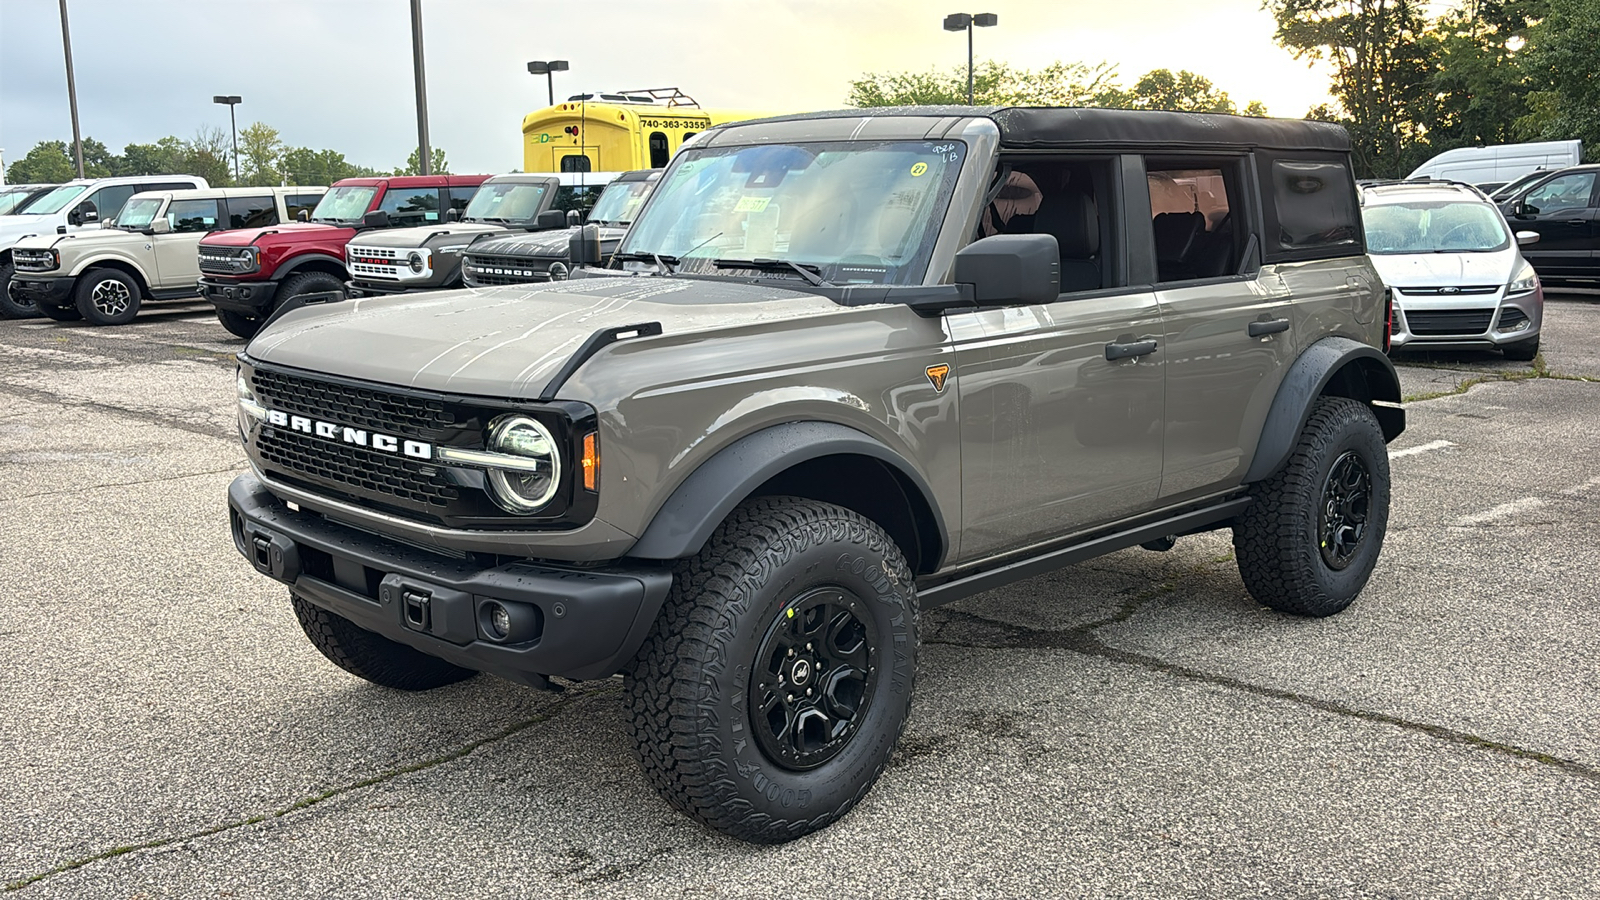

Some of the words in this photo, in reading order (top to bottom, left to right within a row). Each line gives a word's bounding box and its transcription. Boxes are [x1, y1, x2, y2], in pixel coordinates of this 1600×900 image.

[641, 120, 706, 129] 740-363-3355
[912, 165, 925, 174] 27
[477, 267, 532, 276] BRONCO
[269, 410, 432, 459] BRONCO
